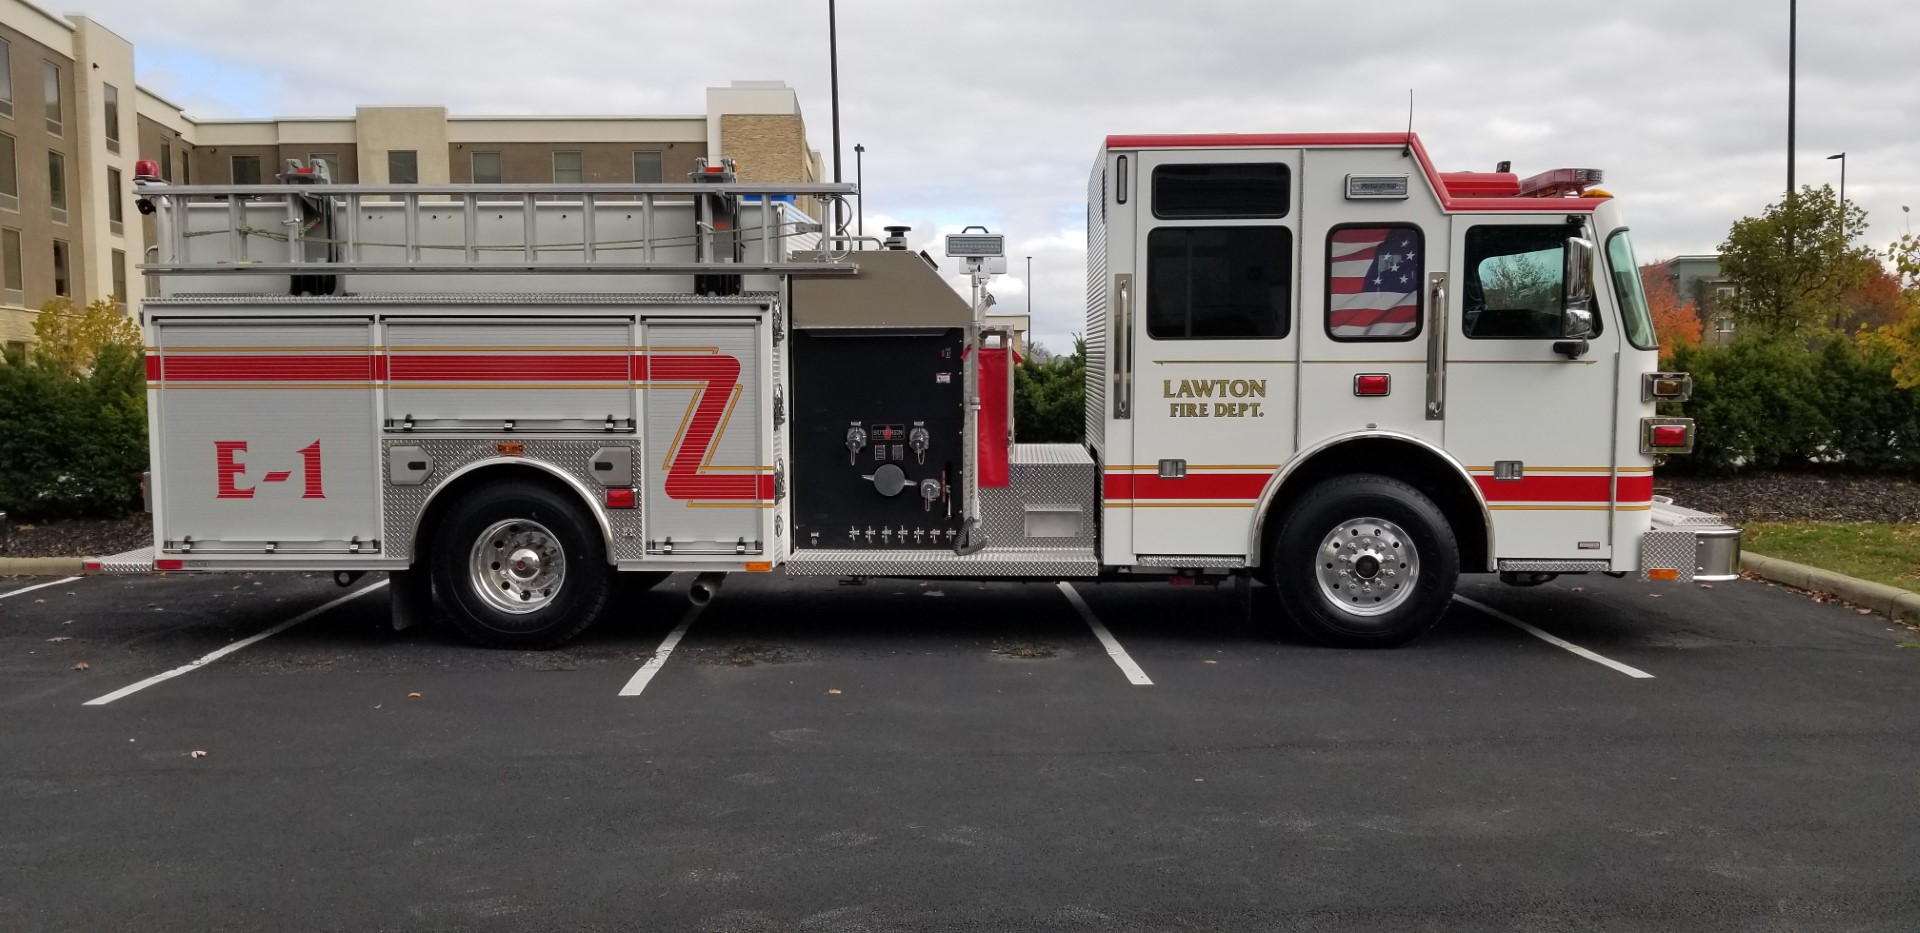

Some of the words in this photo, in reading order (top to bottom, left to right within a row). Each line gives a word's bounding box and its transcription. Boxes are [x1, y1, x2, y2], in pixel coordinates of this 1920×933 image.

[1163, 379, 1267, 398] LAWTON
[1169, 402, 1209, 418] FIRE
[1213, 402, 1264, 418] DEPT.
[213, 439, 327, 498] E-1
